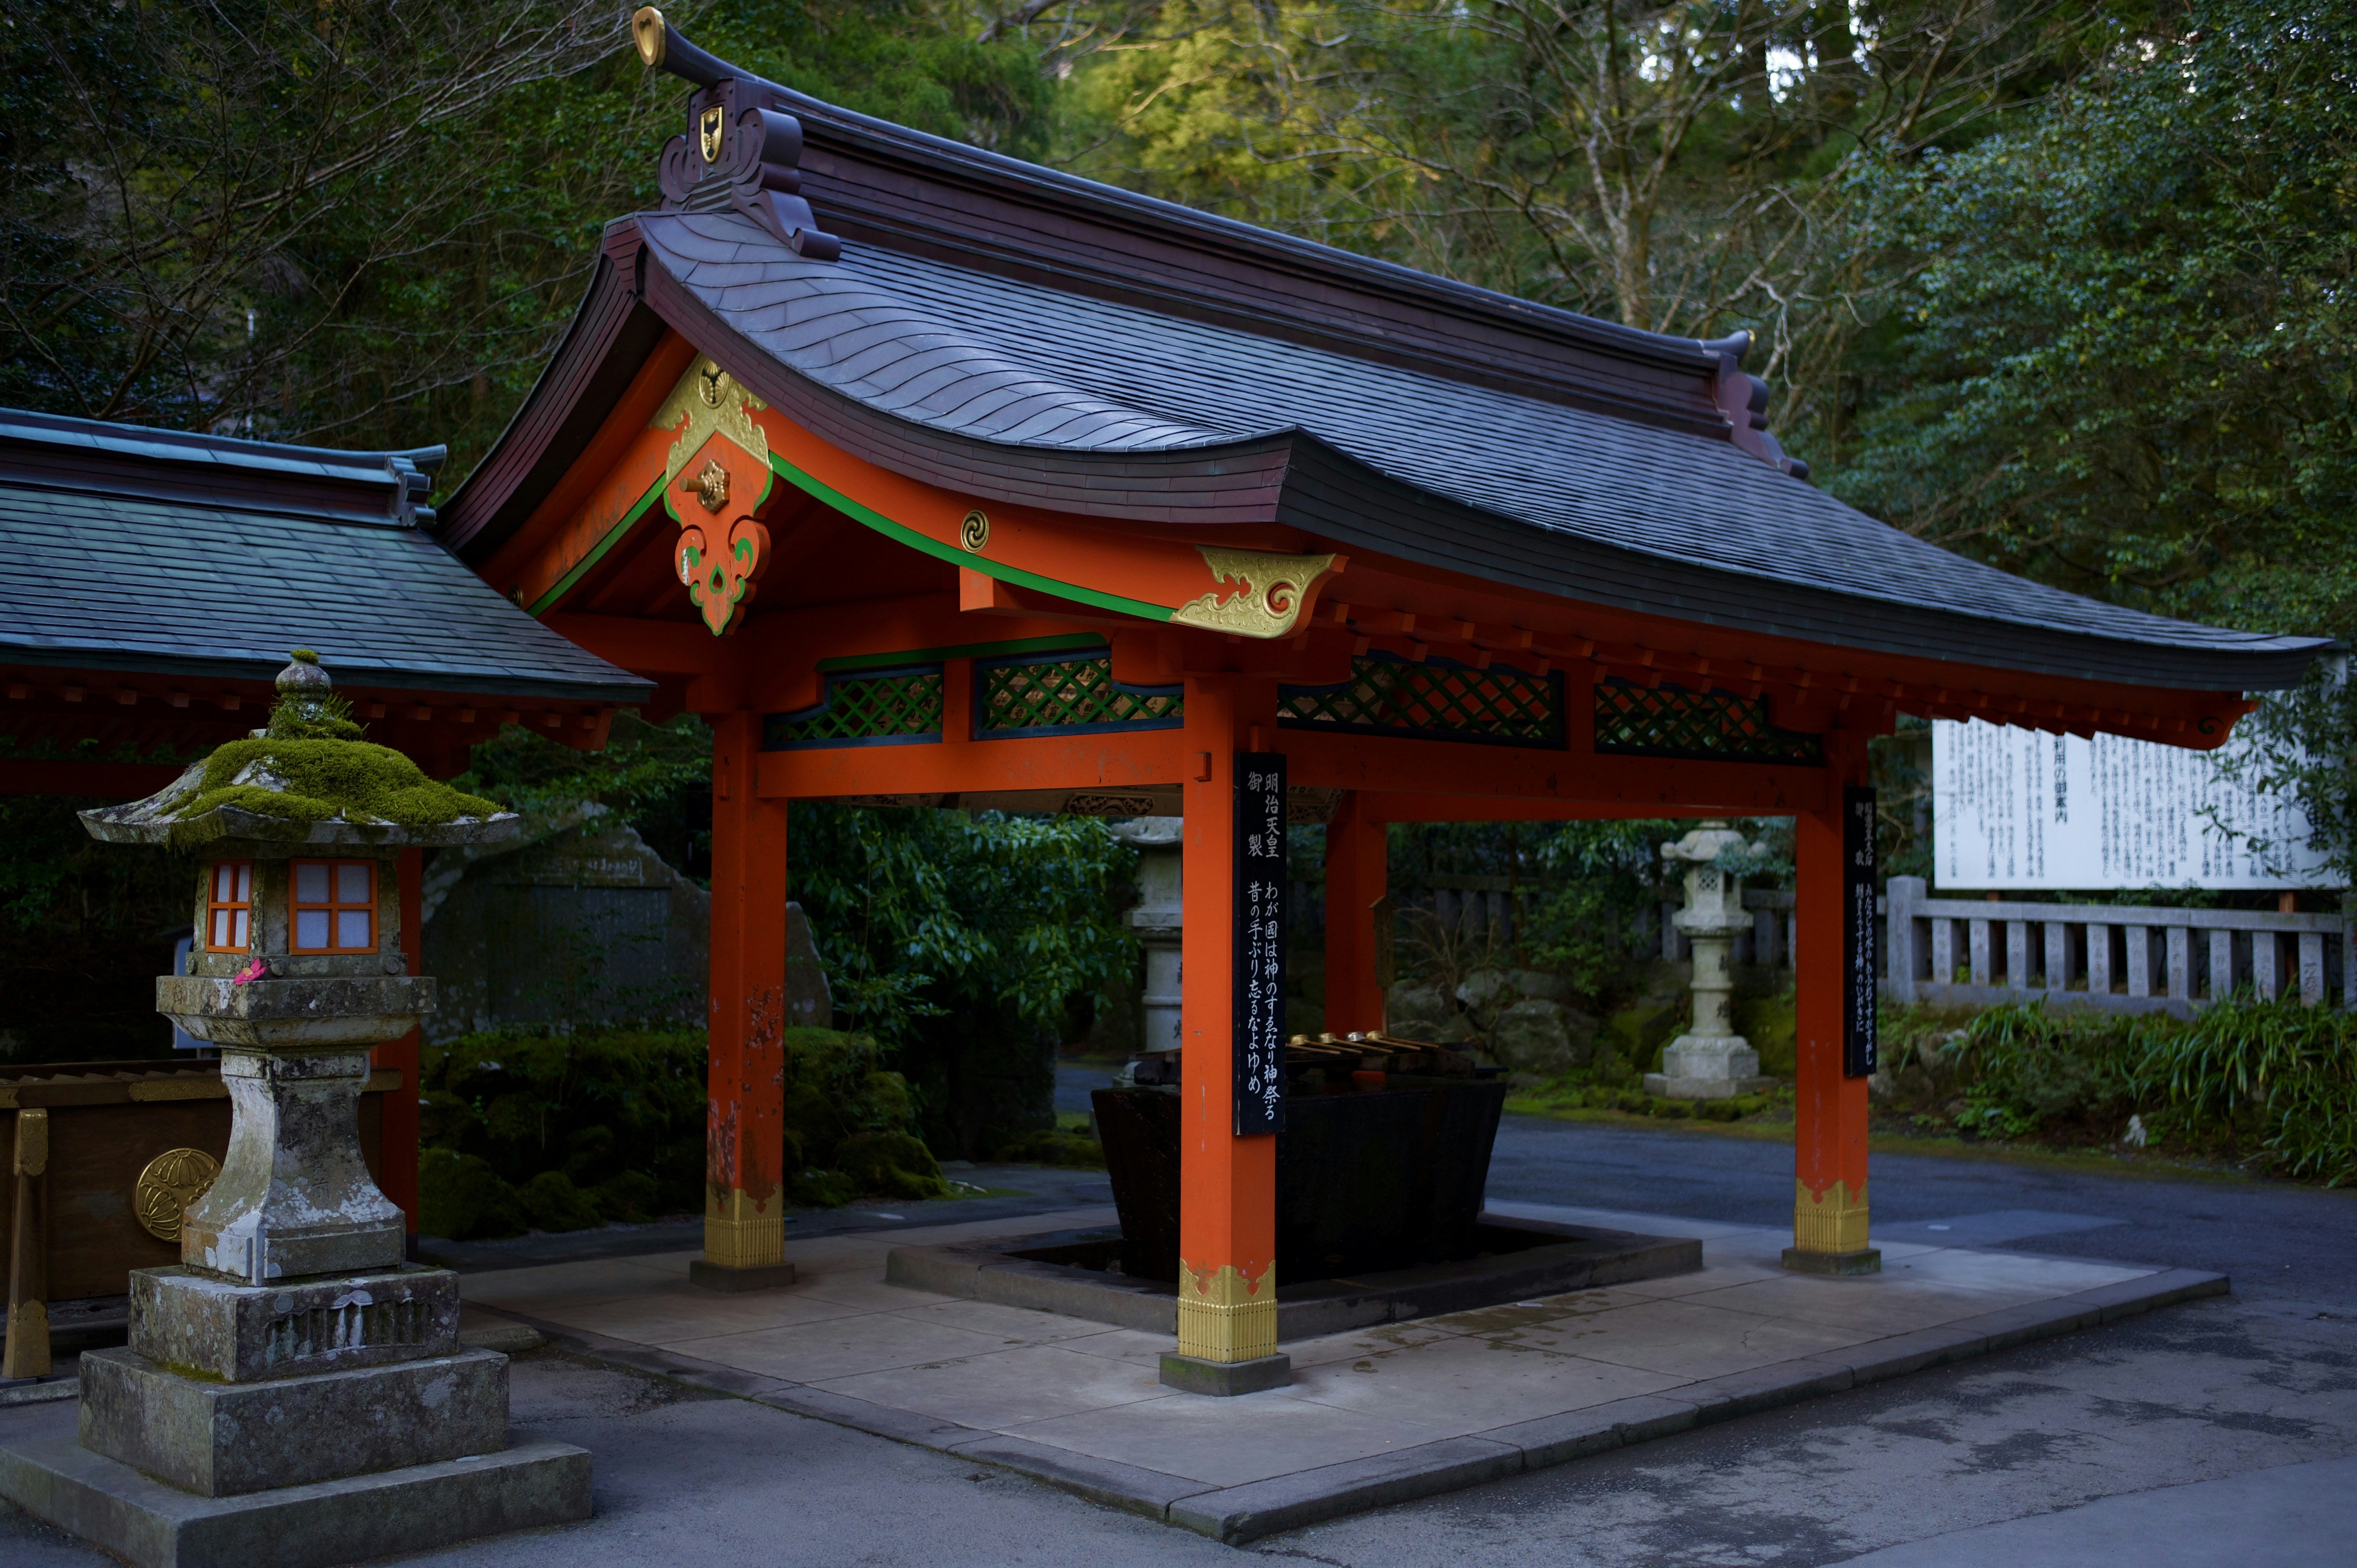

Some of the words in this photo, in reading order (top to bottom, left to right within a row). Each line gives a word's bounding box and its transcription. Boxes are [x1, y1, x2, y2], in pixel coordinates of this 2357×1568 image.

[1247, 771, 1263, 857] 御製
[1265, 773, 1280, 858] 明治天皇
[1248, 880, 1263, 1094] 昔の手ぶり忘るなよゆめ
